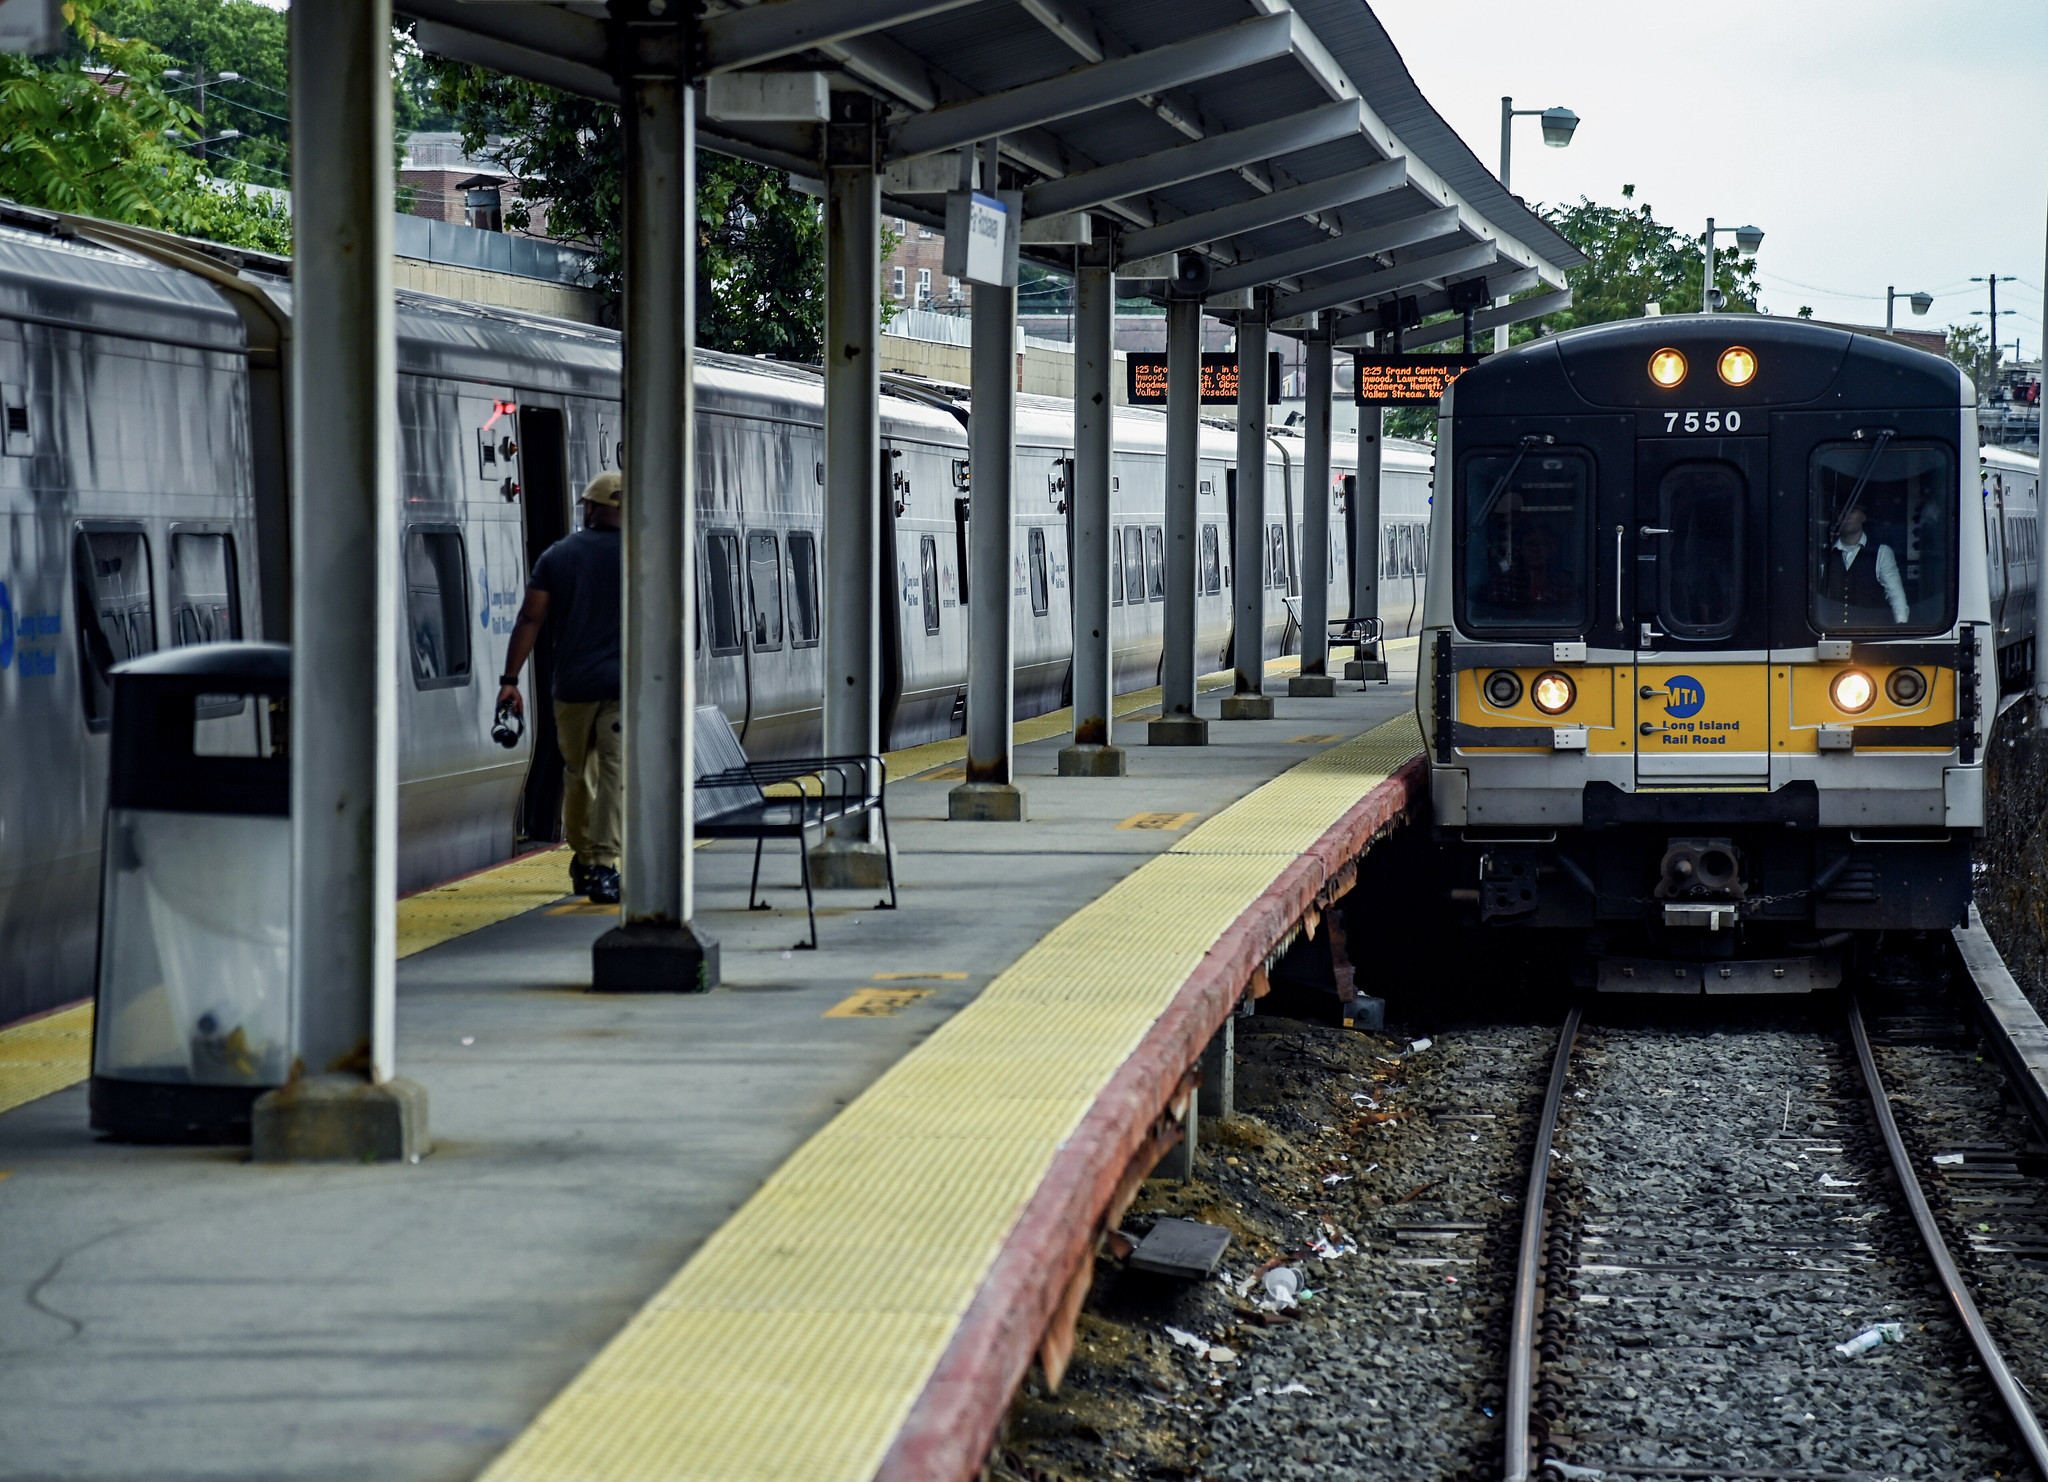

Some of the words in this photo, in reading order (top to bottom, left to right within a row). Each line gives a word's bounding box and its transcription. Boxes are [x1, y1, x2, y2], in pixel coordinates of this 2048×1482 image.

[1154, 365, 1168, 373] Gra
[1222, 365, 1229, 373] in
[1363, 366, 1382, 375] 12:25
[1386, 366, 1411, 375] Grand
[1415, 366, 1447, 375] Central
[1136, 373, 1165, 381] Inwood,
[1363, 374, 1393, 383] Inwood,
[1397, 374, 1441, 383] Lawrence,
[1363, 382, 1406, 391] Woodmere,
[1410, 382, 1443, 391] Hewlett,
[1136, 388, 1160, 397] Valley
[1363, 390, 1388, 398] Valley
[1392, 390, 1425, 398] Stream,
[1664, 411, 1741, 433] 7550
[1664, 687, 1699, 708] MTA
[1663, 720, 1695, 732] Long
[1700, 720, 1740, 730] Island
[1663, 735, 1688, 744] Rail
[1693, 735, 1726, 744] Road
